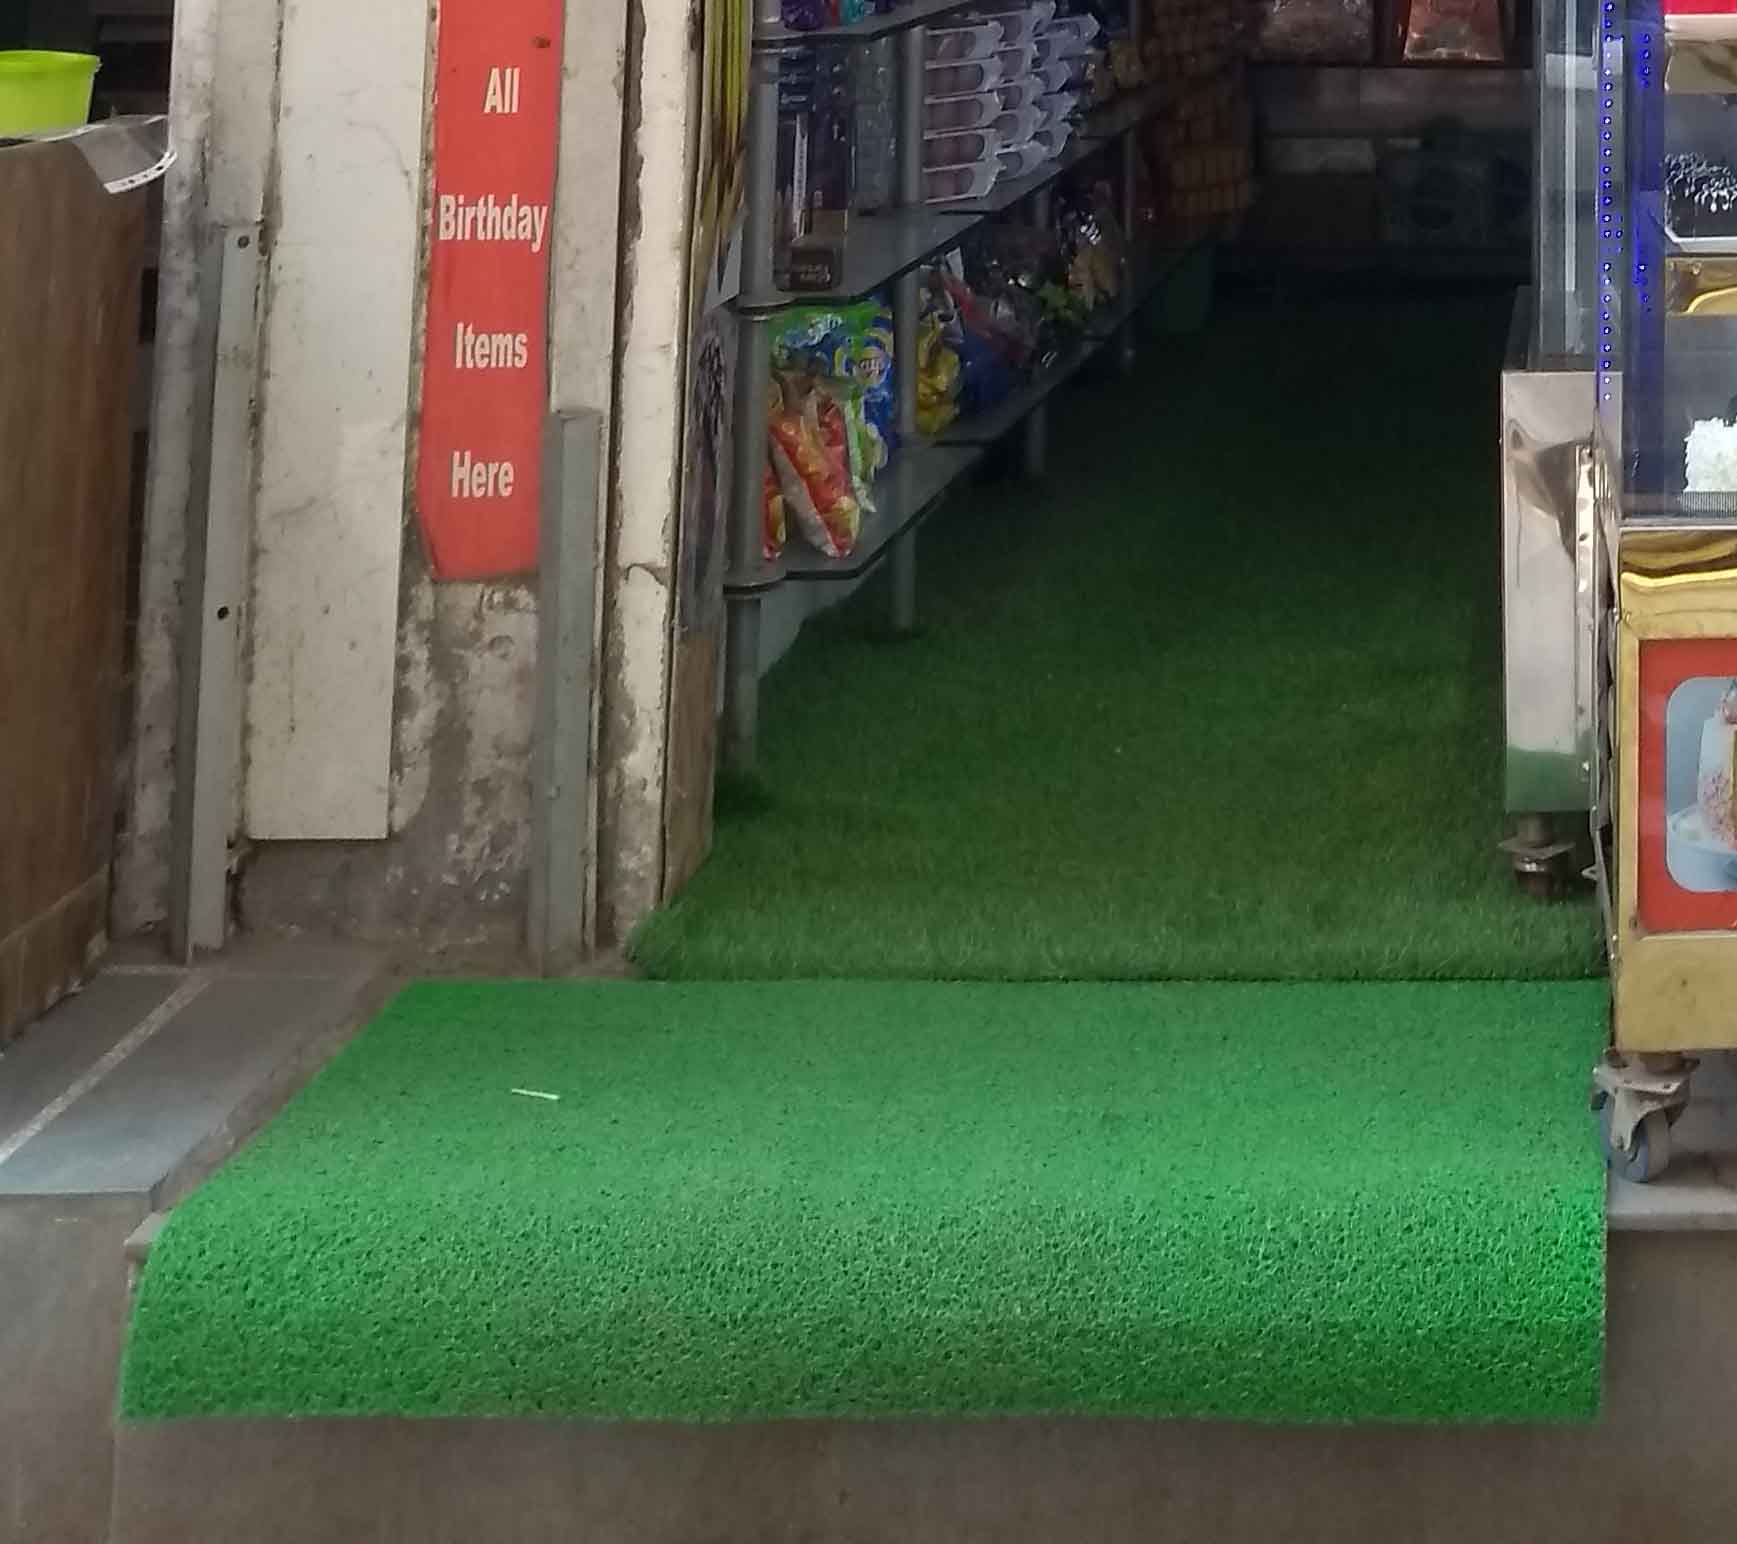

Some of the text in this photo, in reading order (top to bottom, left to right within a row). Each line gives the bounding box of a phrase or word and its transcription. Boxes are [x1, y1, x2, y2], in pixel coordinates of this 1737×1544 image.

[484, 66, 520, 115] All
[438, 193, 548, 254] Birthday
[455, 321, 528, 371] Items
[450, 448, 514, 501] Here
